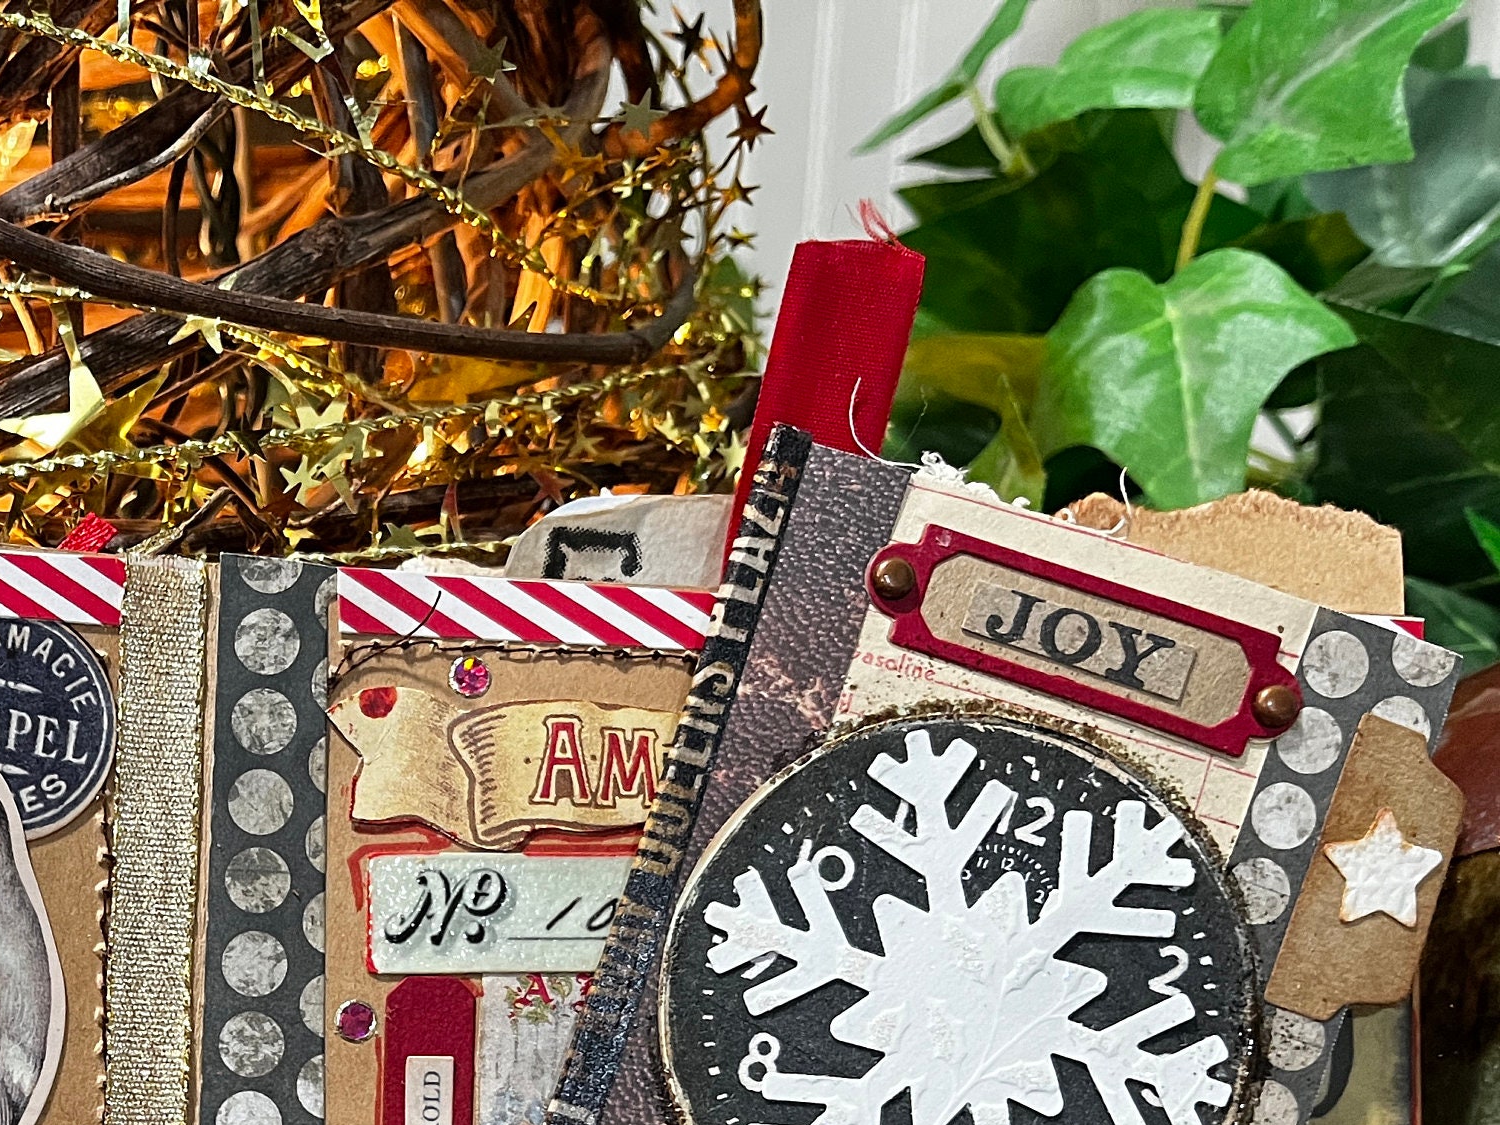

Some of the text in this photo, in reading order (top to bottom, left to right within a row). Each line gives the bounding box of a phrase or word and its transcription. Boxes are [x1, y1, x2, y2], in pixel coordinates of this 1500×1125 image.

[854, 651, 936, 682] asoline
[985, 589, 1177, 690] JOY
[530, 715, 660, 808] AM
